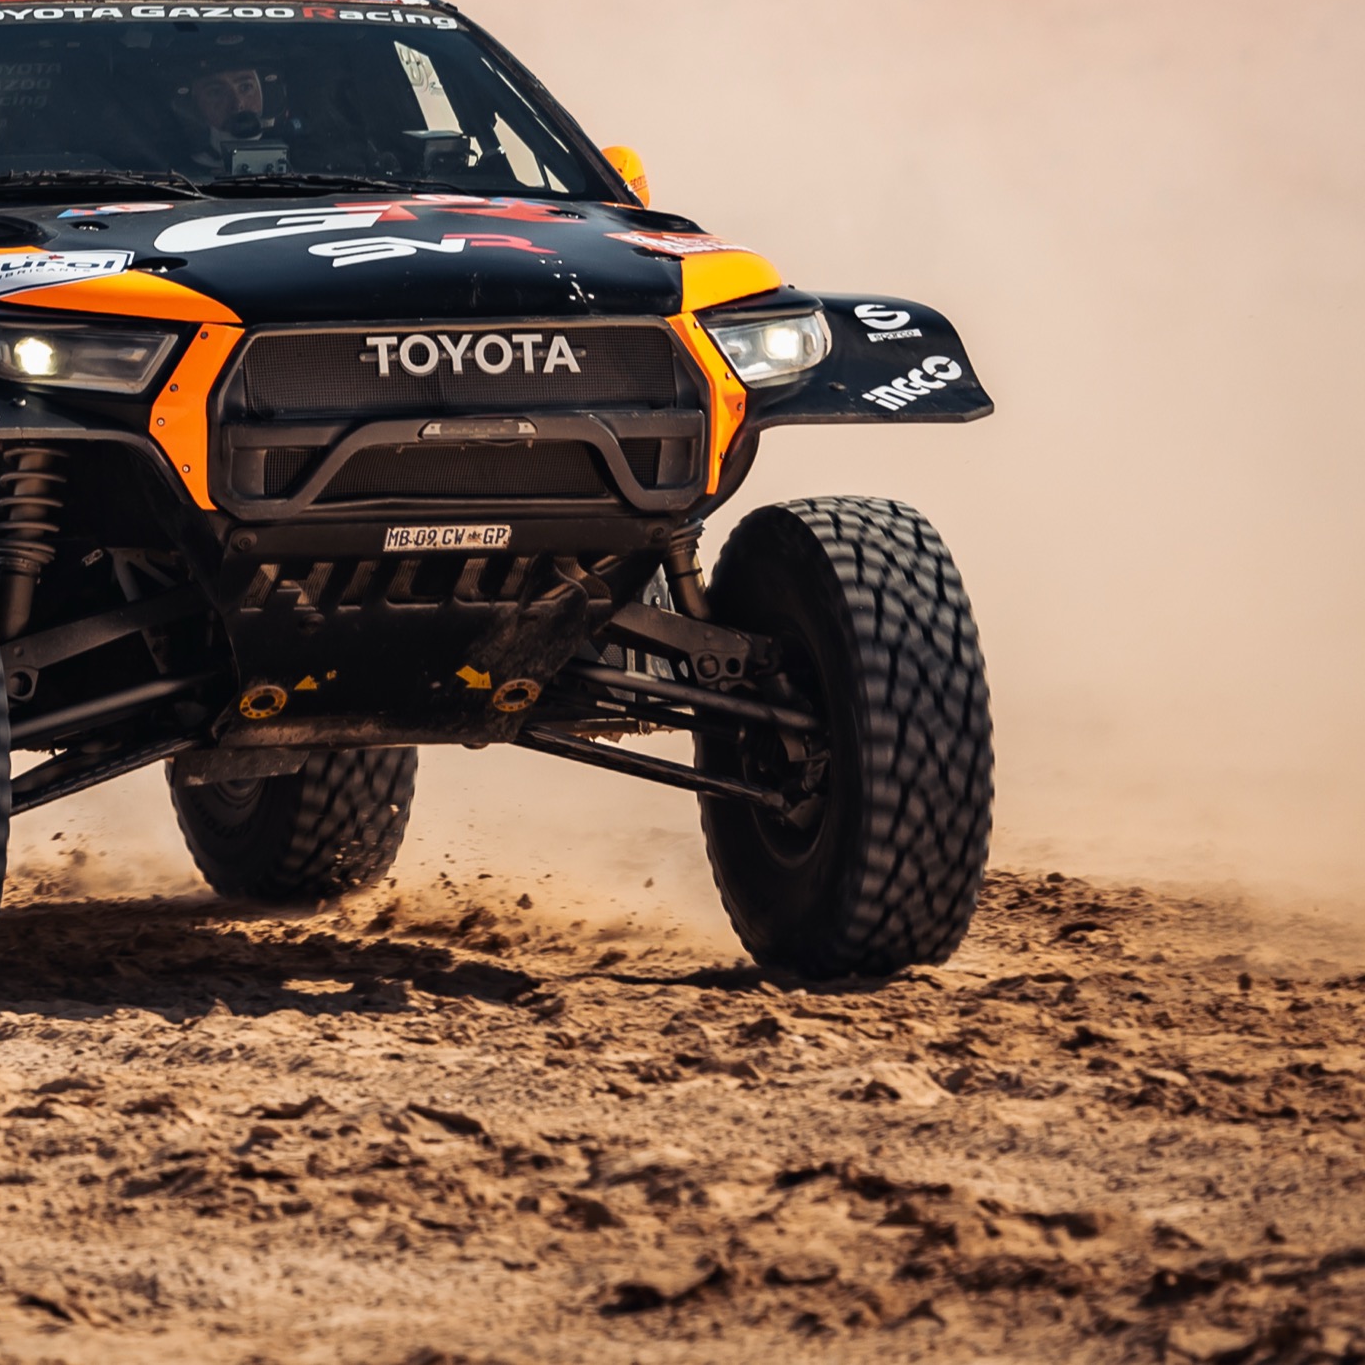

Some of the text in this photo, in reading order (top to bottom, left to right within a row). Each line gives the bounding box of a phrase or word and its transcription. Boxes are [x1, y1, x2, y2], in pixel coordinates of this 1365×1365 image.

[131, 5, 295, 20] GAZOO
[301, 6, 458, 30] Racing
[307, 233, 559, 268] SVR
[366, 333, 582, 377] TOYOTA
[441, 528, 466, 546] CW
[482, 527, 508, 545] GP
